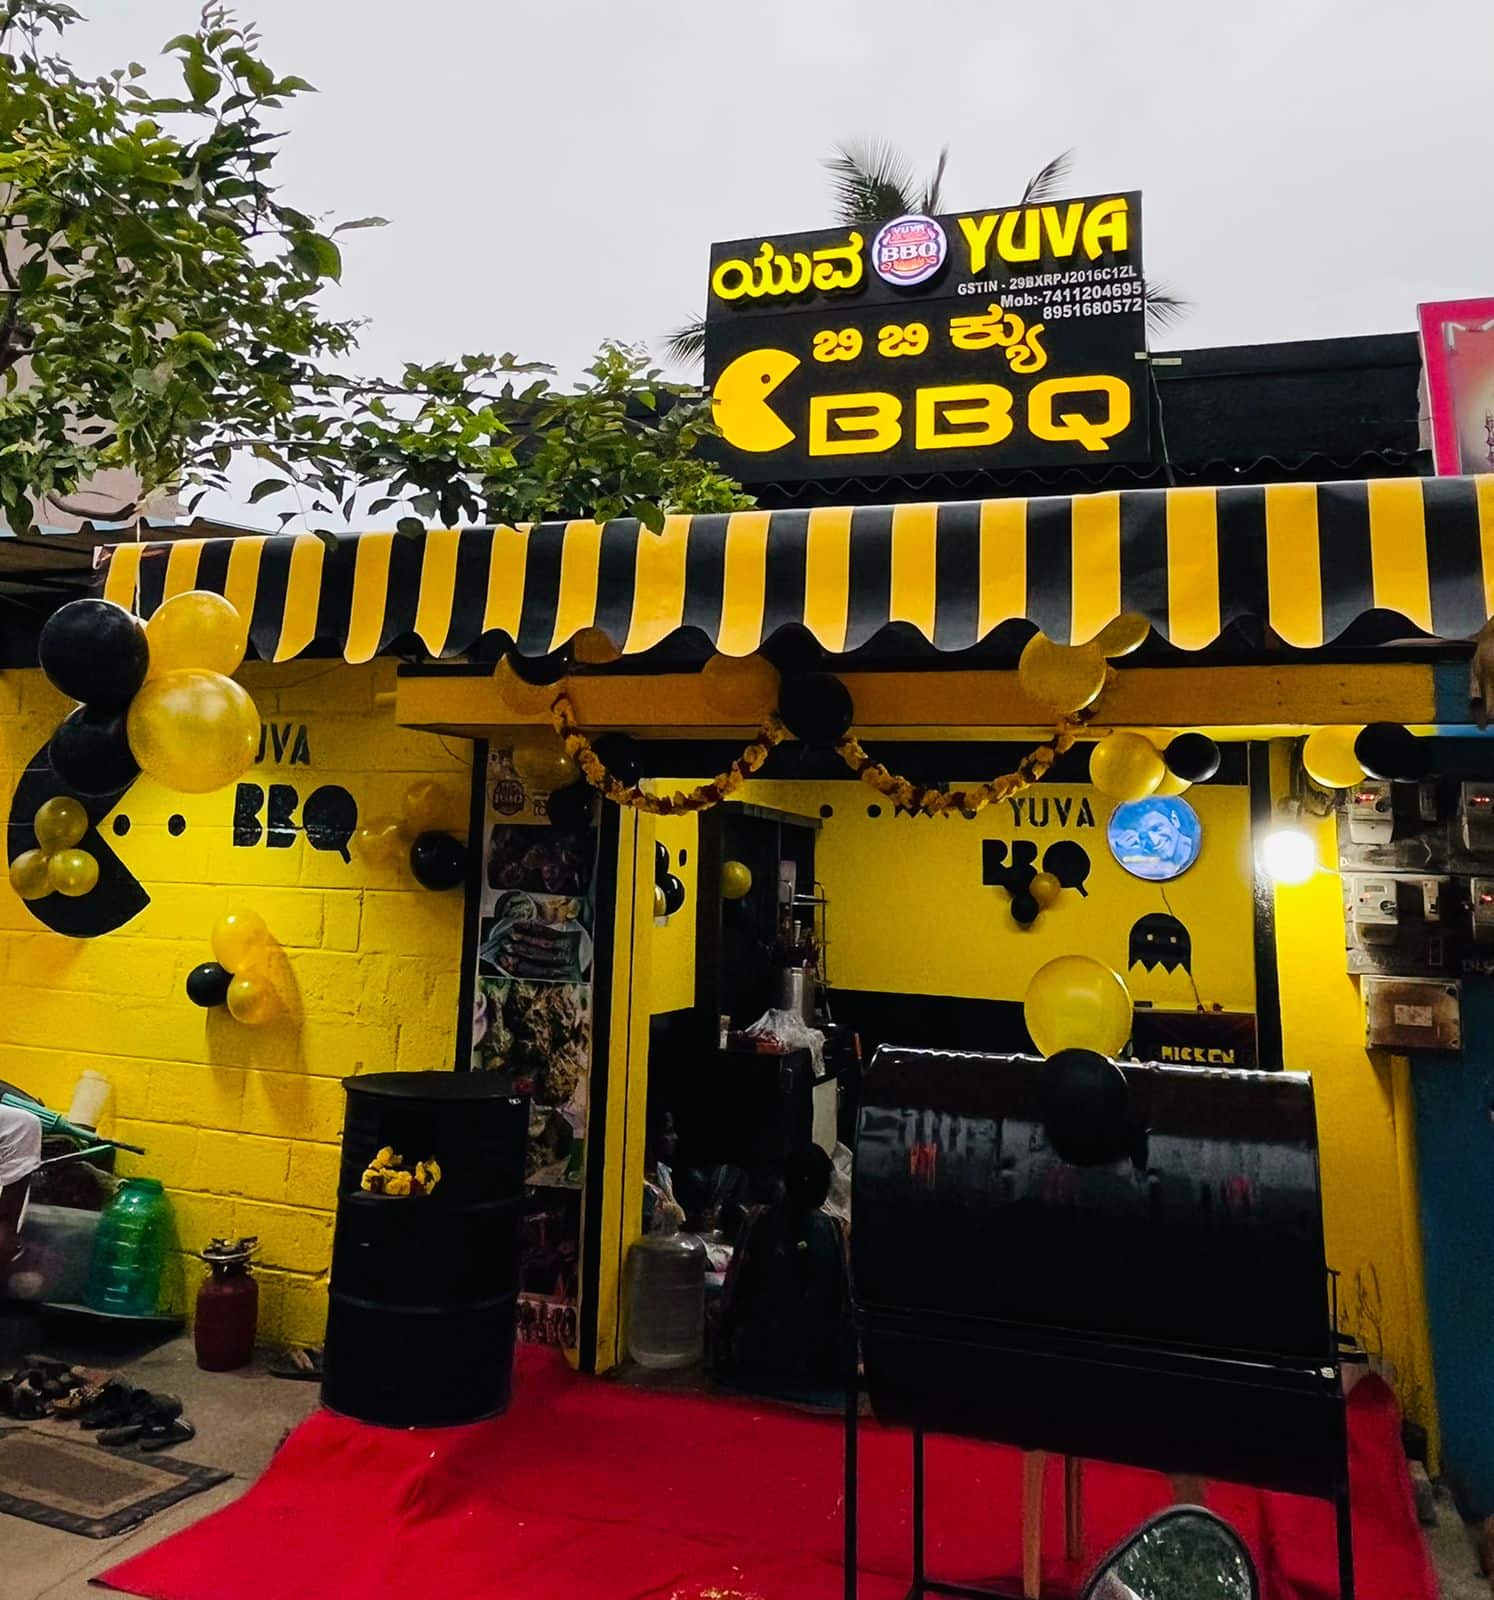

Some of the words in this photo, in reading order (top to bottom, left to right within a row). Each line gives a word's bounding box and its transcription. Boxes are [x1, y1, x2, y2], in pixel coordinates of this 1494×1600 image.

[881, 242, 938, 263] BBQ
[957, 197, 1129, 275] YUVA
[711, 231, 864, 300] ಯುವ
[957, 280, 998, 295] GSTIN
[1009, 265, 1137, 290] 29BXRPJ2016C1ZL
[1000, 281, 1142, 308] Mob:-7411204695
[1042, 298, 1142, 320] 8951680572
[812, 327, 863, 363] ಬಿ
[877, 322, 930, 358] ಬಿ
[808, 374, 1132, 457] BBQ
[254, 721, 311, 766] UVA
[232, 782, 358, 865] BBQ
[1009, 797, 1095, 827] YUVA
